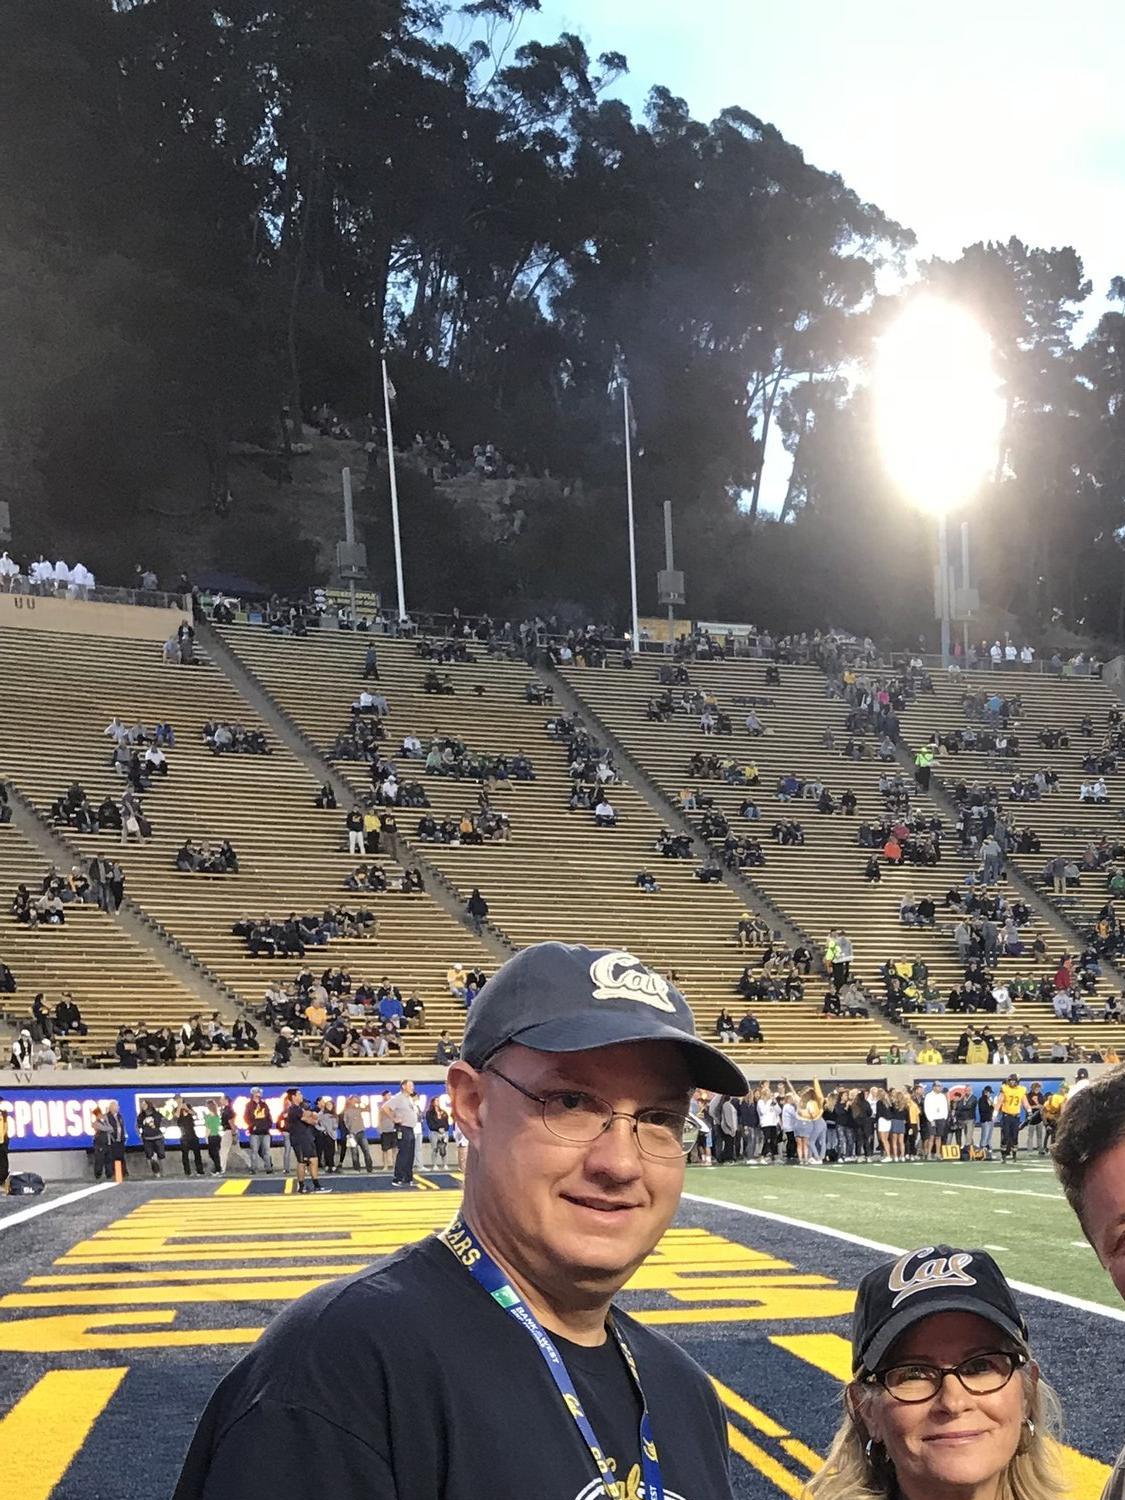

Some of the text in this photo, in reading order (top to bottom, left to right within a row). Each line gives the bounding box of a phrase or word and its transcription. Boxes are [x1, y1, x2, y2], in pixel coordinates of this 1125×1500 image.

[590, 952, 676, 1013] Cal
[240, 1071, 249, 1080] V
[1008, 1095, 1020, 1106] 73
[945, 1146, 958, 1157] 10
[889, 1247, 977, 1309] Cal
